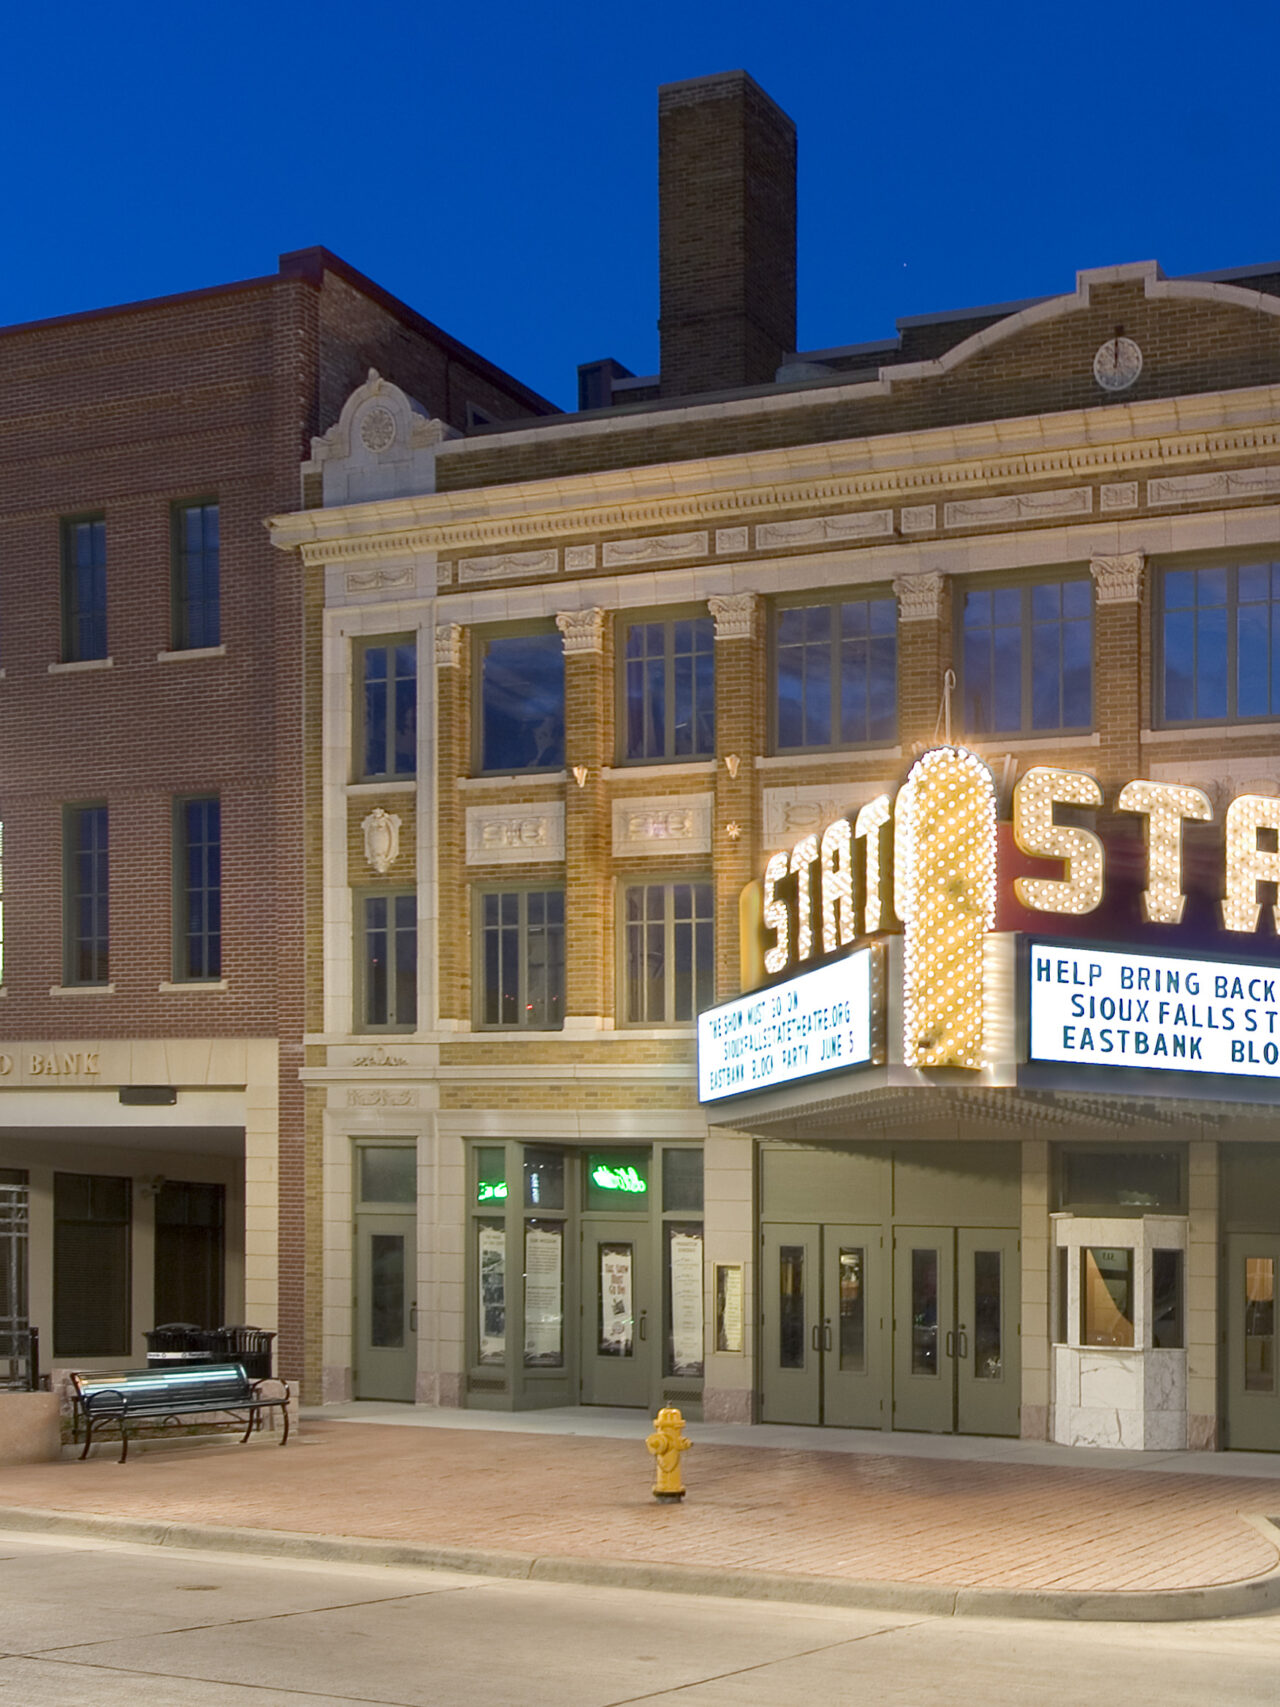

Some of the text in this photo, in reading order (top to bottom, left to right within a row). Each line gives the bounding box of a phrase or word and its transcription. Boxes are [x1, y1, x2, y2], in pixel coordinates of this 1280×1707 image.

[1036, 958, 1102, 987] HELP
[1120, 966, 1200, 996] BRING
[1214, 975, 1276, 1003] BACK
[724, 1009, 743, 1035] SHOW
[1063, 1025, 1202, 1060] EASTBANK
[28, 1053, 100, 1076] BANK
[710, 1063, 745, 1091] EASTBANK
[820, 1034, 842, 1061] JUNE
